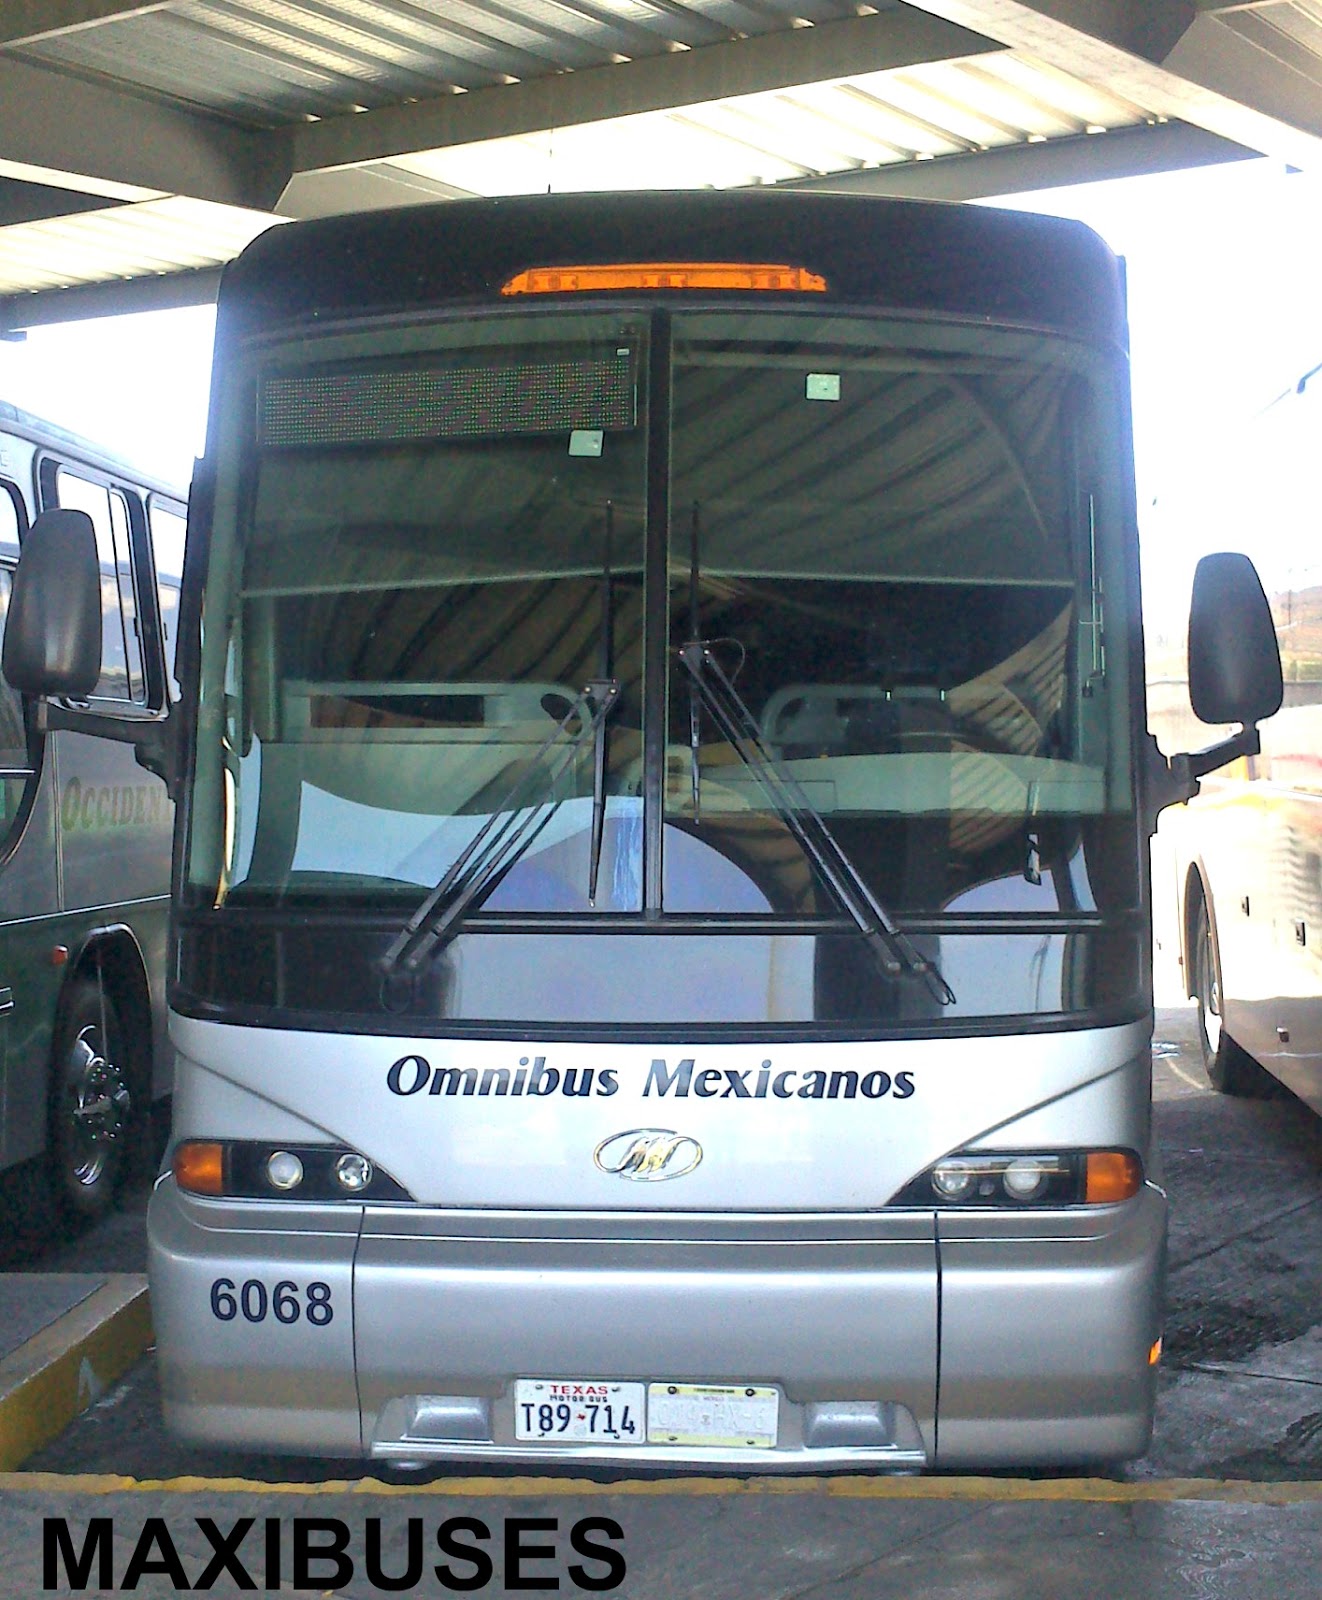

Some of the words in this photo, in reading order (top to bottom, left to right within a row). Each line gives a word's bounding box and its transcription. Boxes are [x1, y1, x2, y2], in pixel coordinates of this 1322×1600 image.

[386, 1054, 619, 1097] Omnibus
[641, 1056, 916, 1100] Mexicanos
[210, 1277, 334, 1326] 6068
[549, 1385, 608, 1395] TEXAS
[520, 1403, 571, 1432] T89
[585, 1404, 636, 1434] 714
